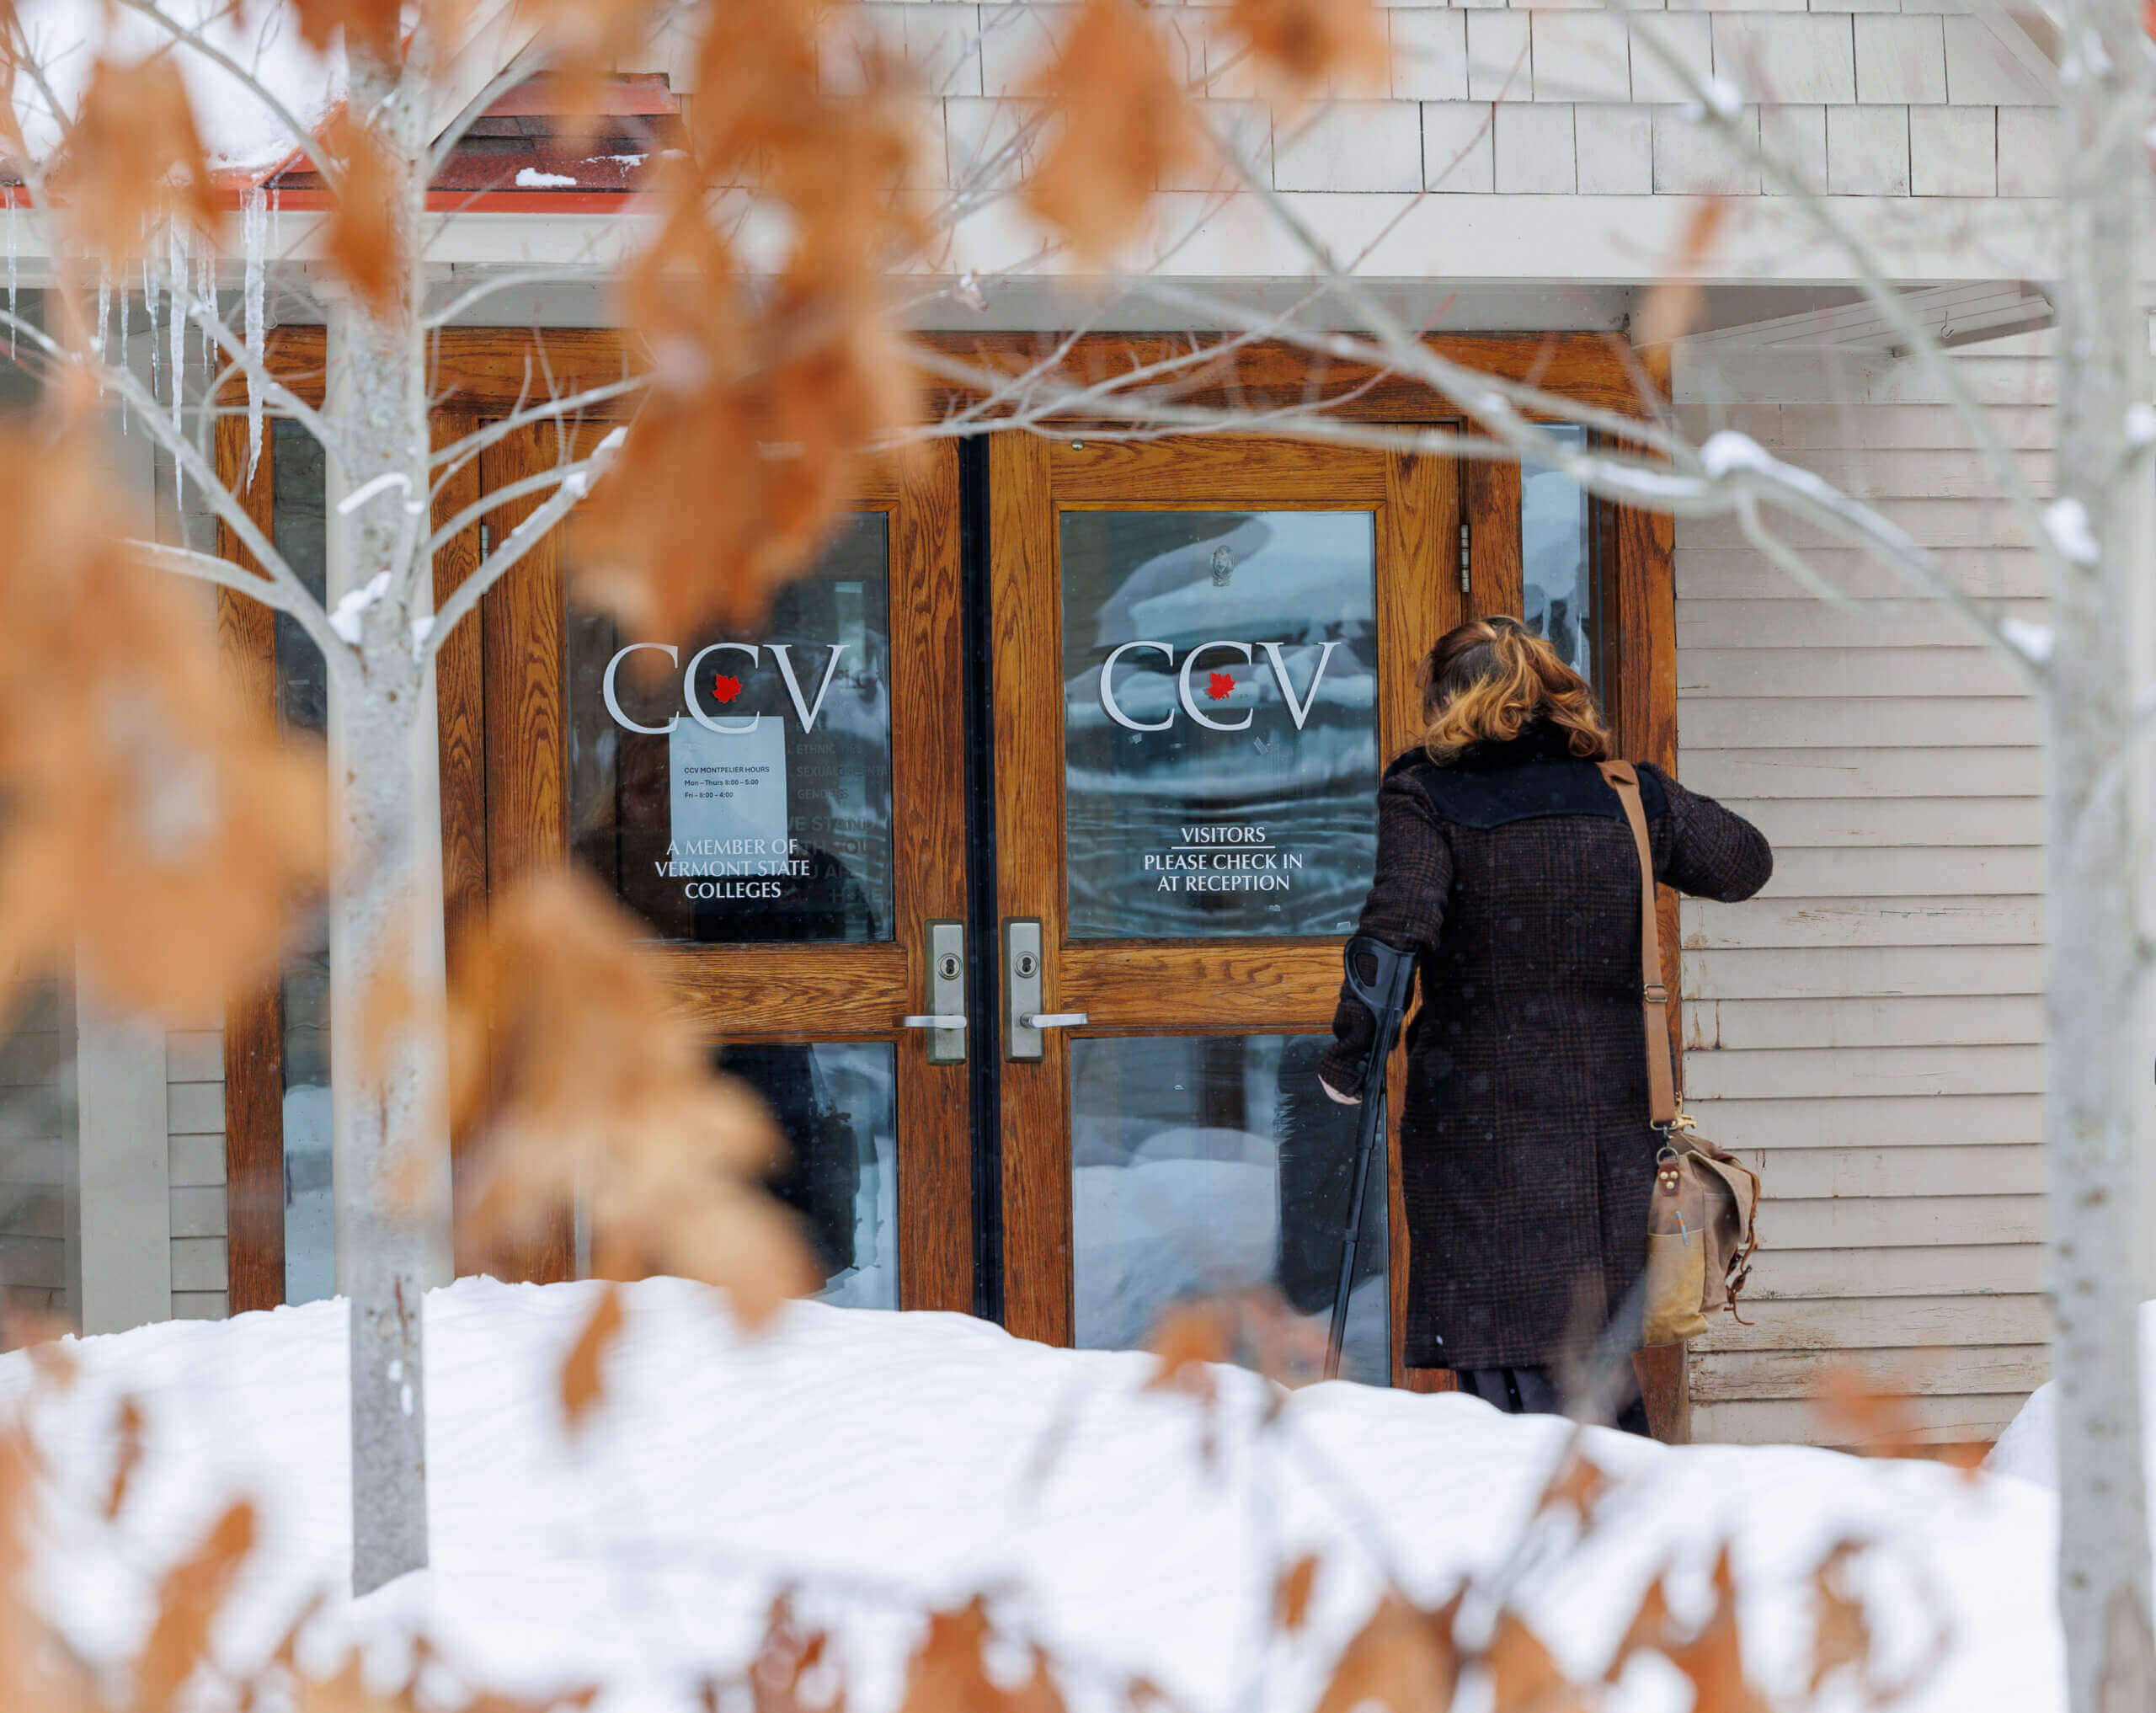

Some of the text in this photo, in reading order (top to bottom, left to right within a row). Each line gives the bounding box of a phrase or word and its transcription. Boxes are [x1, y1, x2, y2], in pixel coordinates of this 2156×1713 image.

[602, 642, 851, 734] CCV
[1099, 640, 1342, 731] CCV
[1181, 826, 1267, 843] VISITORS
[666, 840, 680, 855] A
[684, 839, 772, 855] MEMBER
[779, 839, 798, 854] OF
[654, 861, 750, 878] VERMONT
[757, 859, 810, 876] STATE
[1144, 853, 1303, 871] PLEASE CHECK IN
[685, 882, 782, 899] COLLEGES
[1157, 875, 1290, 892] AT RECEPTION
